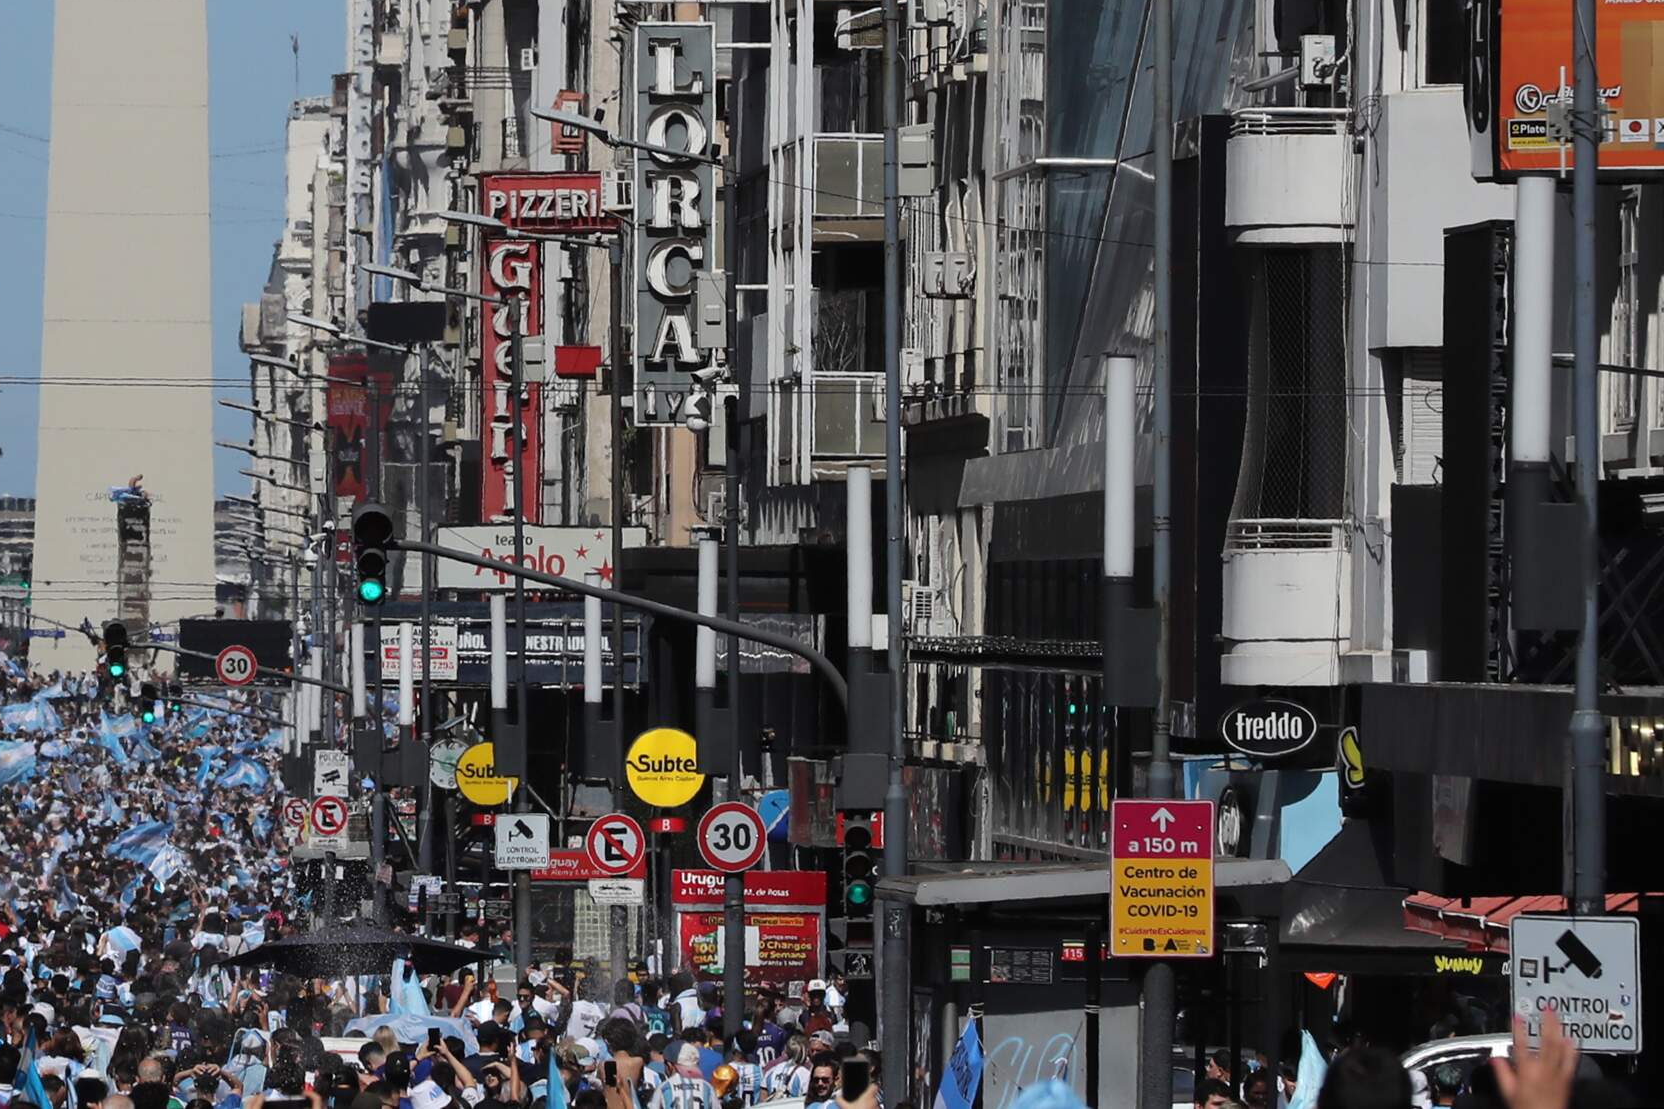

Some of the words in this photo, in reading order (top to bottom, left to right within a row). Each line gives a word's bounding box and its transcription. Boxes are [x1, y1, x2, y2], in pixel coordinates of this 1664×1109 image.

[488, 188, 605, 219] PIZZERI
[644, 38, 708, 371] LORCA
[495, 534, 534, 546] teao
[225, 657, 248, 675] 30
[1235, 711, 1303, 740] freddo
[637, 753, 698, 774] Subte
[662, 819, 671, 831] B
[713, 823, 752, 851] 30
[1128, 841, 1139, 853] a
[1144, 837, 1176, 853] 150
[1180, 841, 1198, 853] m
[681, 872, 725, 888] Urugu
[1123, 865, 1175, 879] Centro
[1178, 865, 1198, 879] de
[1119, 884, 1206, 899] Vacunación
[1127, 904, 1199, 918] COVID-19
[1062, 948, 1084, 958] 115
